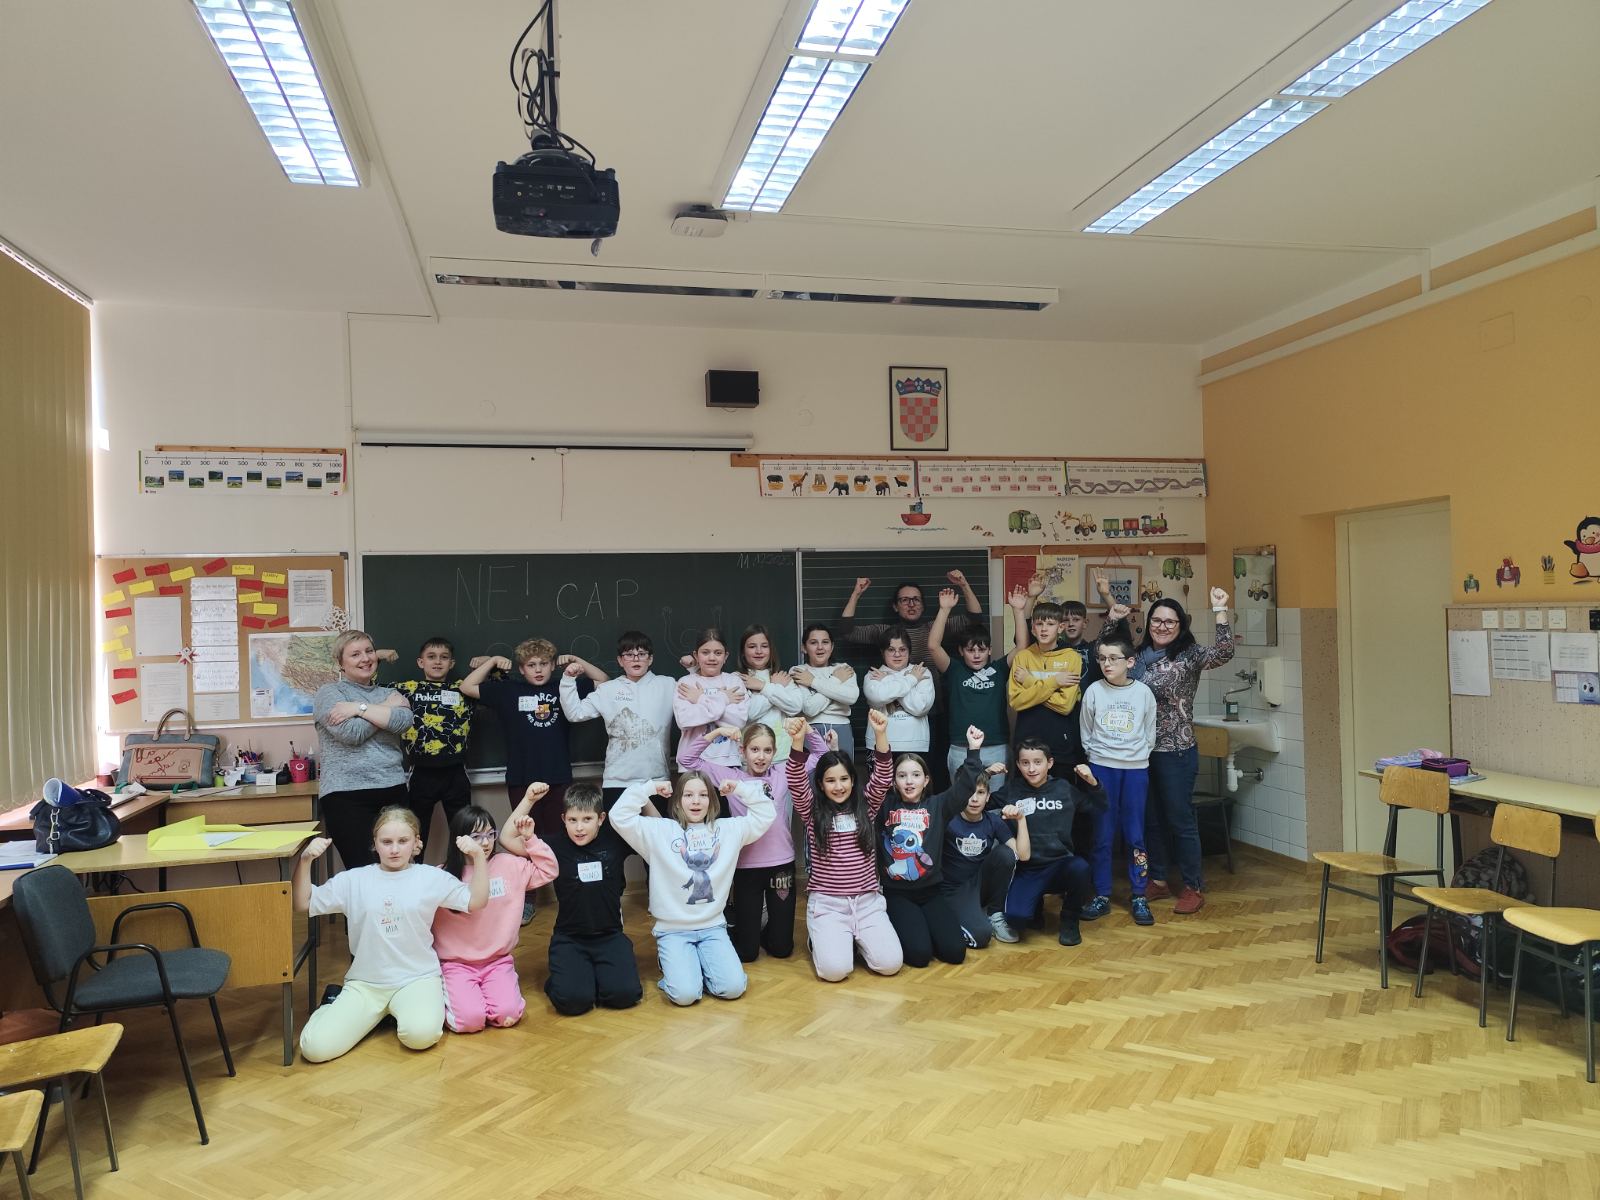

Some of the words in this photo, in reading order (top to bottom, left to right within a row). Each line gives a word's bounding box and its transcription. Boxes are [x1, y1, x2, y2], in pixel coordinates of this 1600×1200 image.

[455, 561, 529, 626] NE!
[557, 579, 639, 620] CAP
[962, 679, 995, 690] adidas
[415, 691, 442, 702] Poké
[769, 875, 791, 889] LOVE
